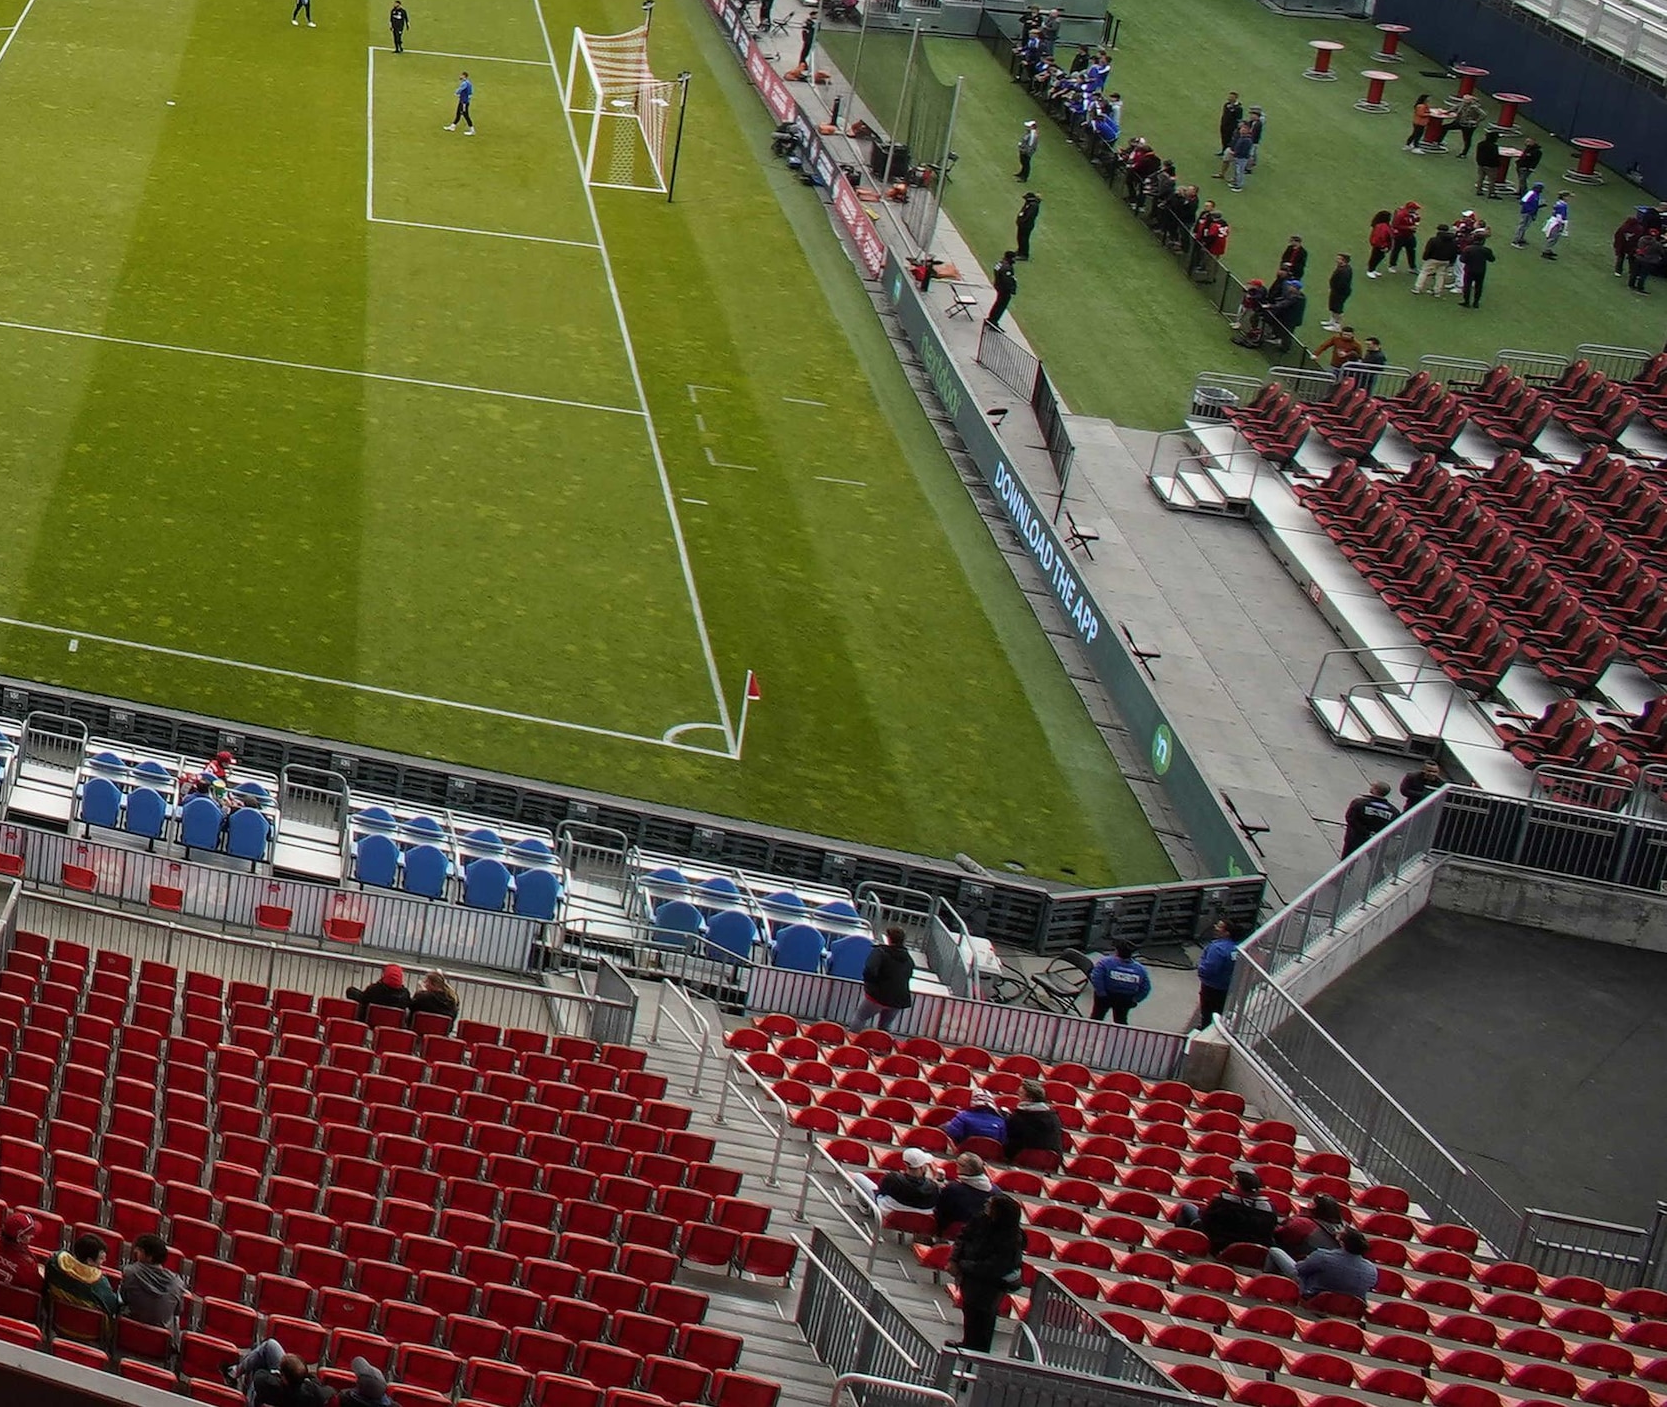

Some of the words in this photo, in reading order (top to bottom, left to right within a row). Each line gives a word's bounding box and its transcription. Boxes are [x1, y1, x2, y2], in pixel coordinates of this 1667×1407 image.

[994, 461, 1054, 571] DOWNLOAD
[1051, 555, 1077, 610] THE
[1072, 596, 1099, 644] APP
